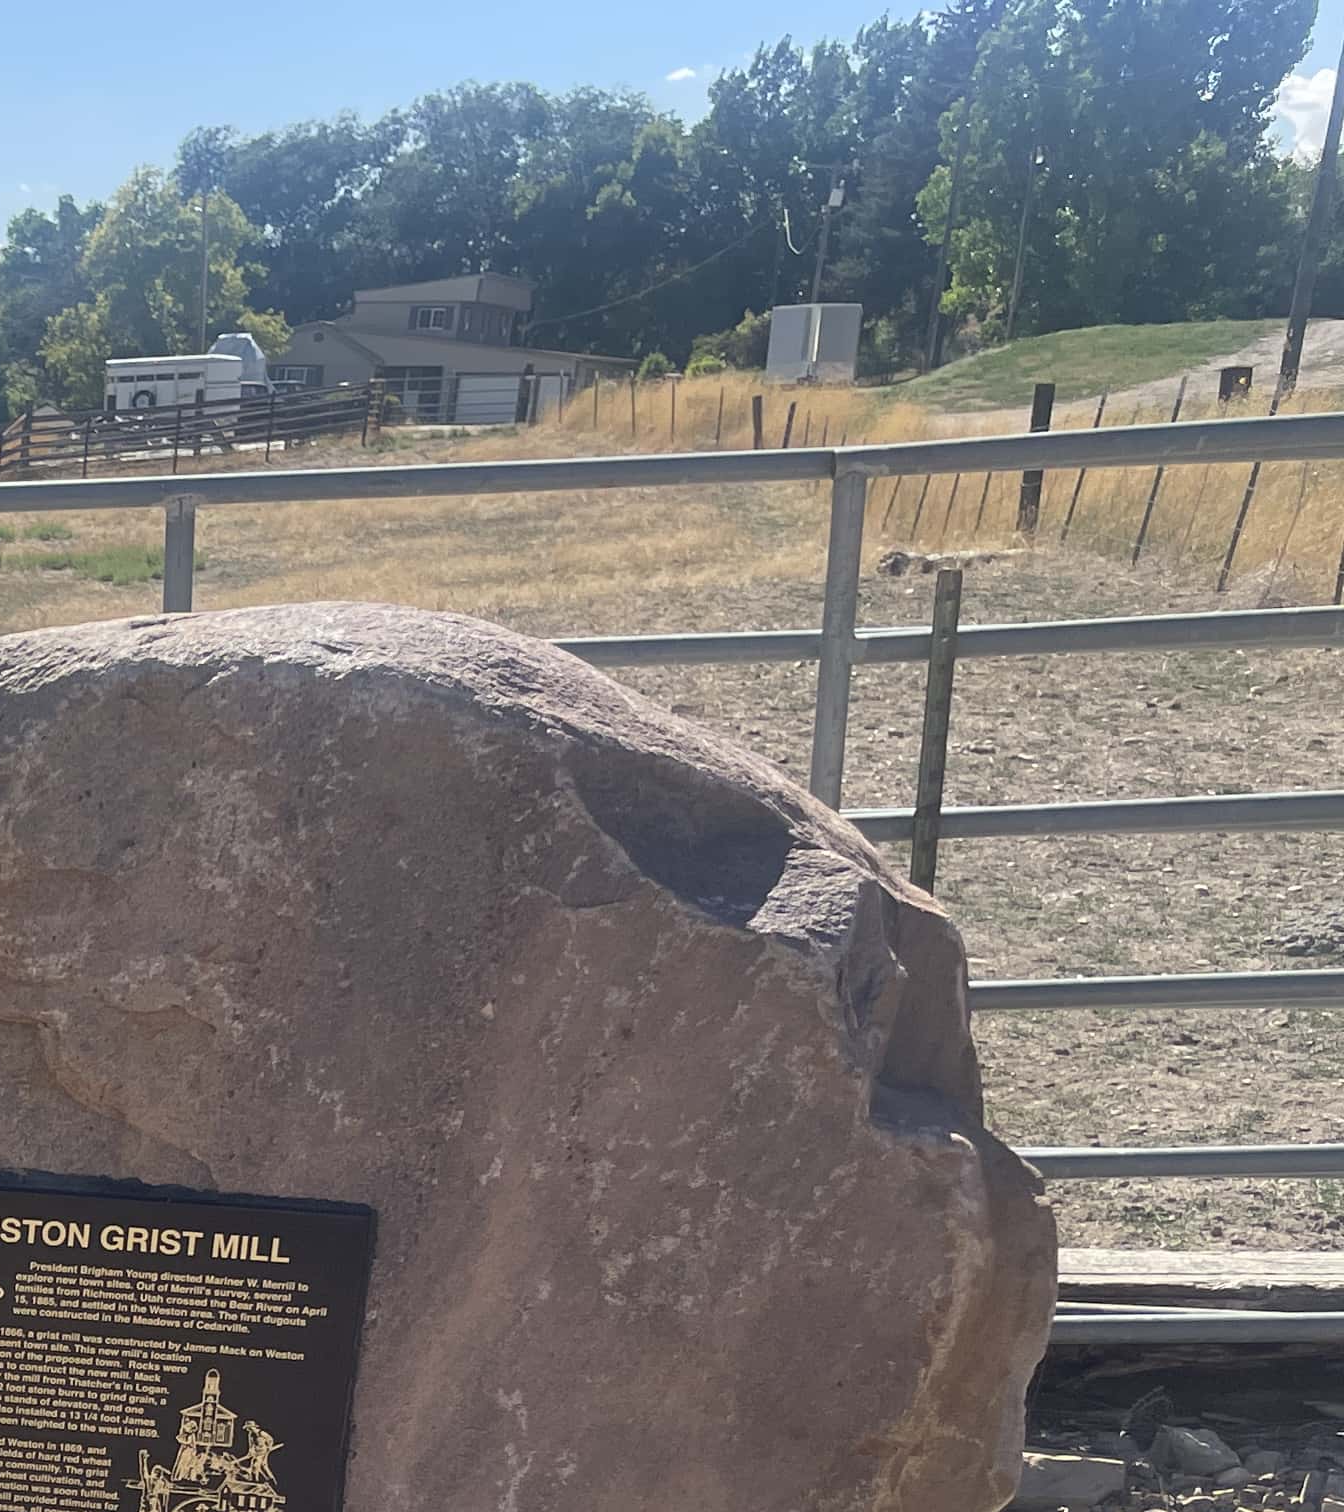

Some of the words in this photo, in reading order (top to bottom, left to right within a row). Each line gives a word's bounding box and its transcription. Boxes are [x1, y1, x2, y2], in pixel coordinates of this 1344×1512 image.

[99, 1224, 203, 1257] GRIST
[211, 1233, 292, 1264] MILL
[15, 1272, 54, 1285] explore
[55, 1276, 77, 1285] new
[78, 1276, 104, 1287] town
[136, 1281, 155, 1291] Out
[157, 1282, 168, 1292] of
[253, 1290, 291, 1301] several
[29, 1261, 78, 1273] President
[80, 1265, 123, 1278] Brigham
[125, 1268, 158, 1281] Young
[160, 1271, 203, 1283] directed
[204, 1274, 244, 1286] Mariner
[262, 1279, 295, 1290] Merrill
[297, 1282, 309, 1291] to
[14, 1283, 54, 1294] families
[56, 1286, 80, 1296] from
[139, 1292, 164, 1303] Utah
[165, 1294, 208, 1306] crossed
[209, 1298, 227, 1308] the
[229, 1299, 254, 1310] Bear
[255, 1301, 283, 1312] River
[285, 1305, 299, 1313] on
[301, 1305, 327, 1317] April
[12, 1307, 37, 1316] were
[39, 1307, 99, 1321] constructed
[101, 1312, 111, 1322] in
[113, 1313, 130, 1323] the
[132, 1315, 180, 1327] Meadows
[182, 1319, 194, 1328] of
[59, 1297, 79, 1307] and
[81, 1299, 116, 1310] settled
[118, 1302, 128, 1311] in
[130, 1303, 147, 1313] the
[148, 1305, 188, 1316] Weston
[217, 1310, 238, 1320] The
[239, 1312, 261, 1322] first
[262, 1314, 306, 1328] dugouts
[23, 1340, 48, 1350] town
[73, 1344, 96, 1354] This
[98, 1347, 119, 1356] new
[150, 1350, 191, 1362] location
[27, 1330, 34, 1338] a
[35, 1329, 60, 1341] grist
[61, 1332, 80, 1341] mill
[82, 1335, 103, 1343] was
[104, 1335, 166, 1349] constructed
[167, 1340, 181, 1352] by
[183, 1342, 217, 1353] James
[219, 1345, 246, 1355] Mack
[248, 1349, 263, 1357] on
[264, 1348, 304, 1360] Weston
[3, 1371, 20, 1381] the
[21, 1373, 40, 1383] mill
[42, 1375, 66, 1385] from
[123, 1382, 133, 1391] in
[20, 1417, 65, 1430] freighted
[67, 1421, 78, 1430] to
[79, 1422, 96, 1432] the
[98, 1424, 122, 1434] west
[7, 1437, 45, 1449] Weston
[46, 1441, 56, 1450] in
[87, 1444, 106, 1454] and
[63, 1465, 84, 1474] The
[85, 1467, 108, 1478] grist
[85, 1477, 105, 1487] and
